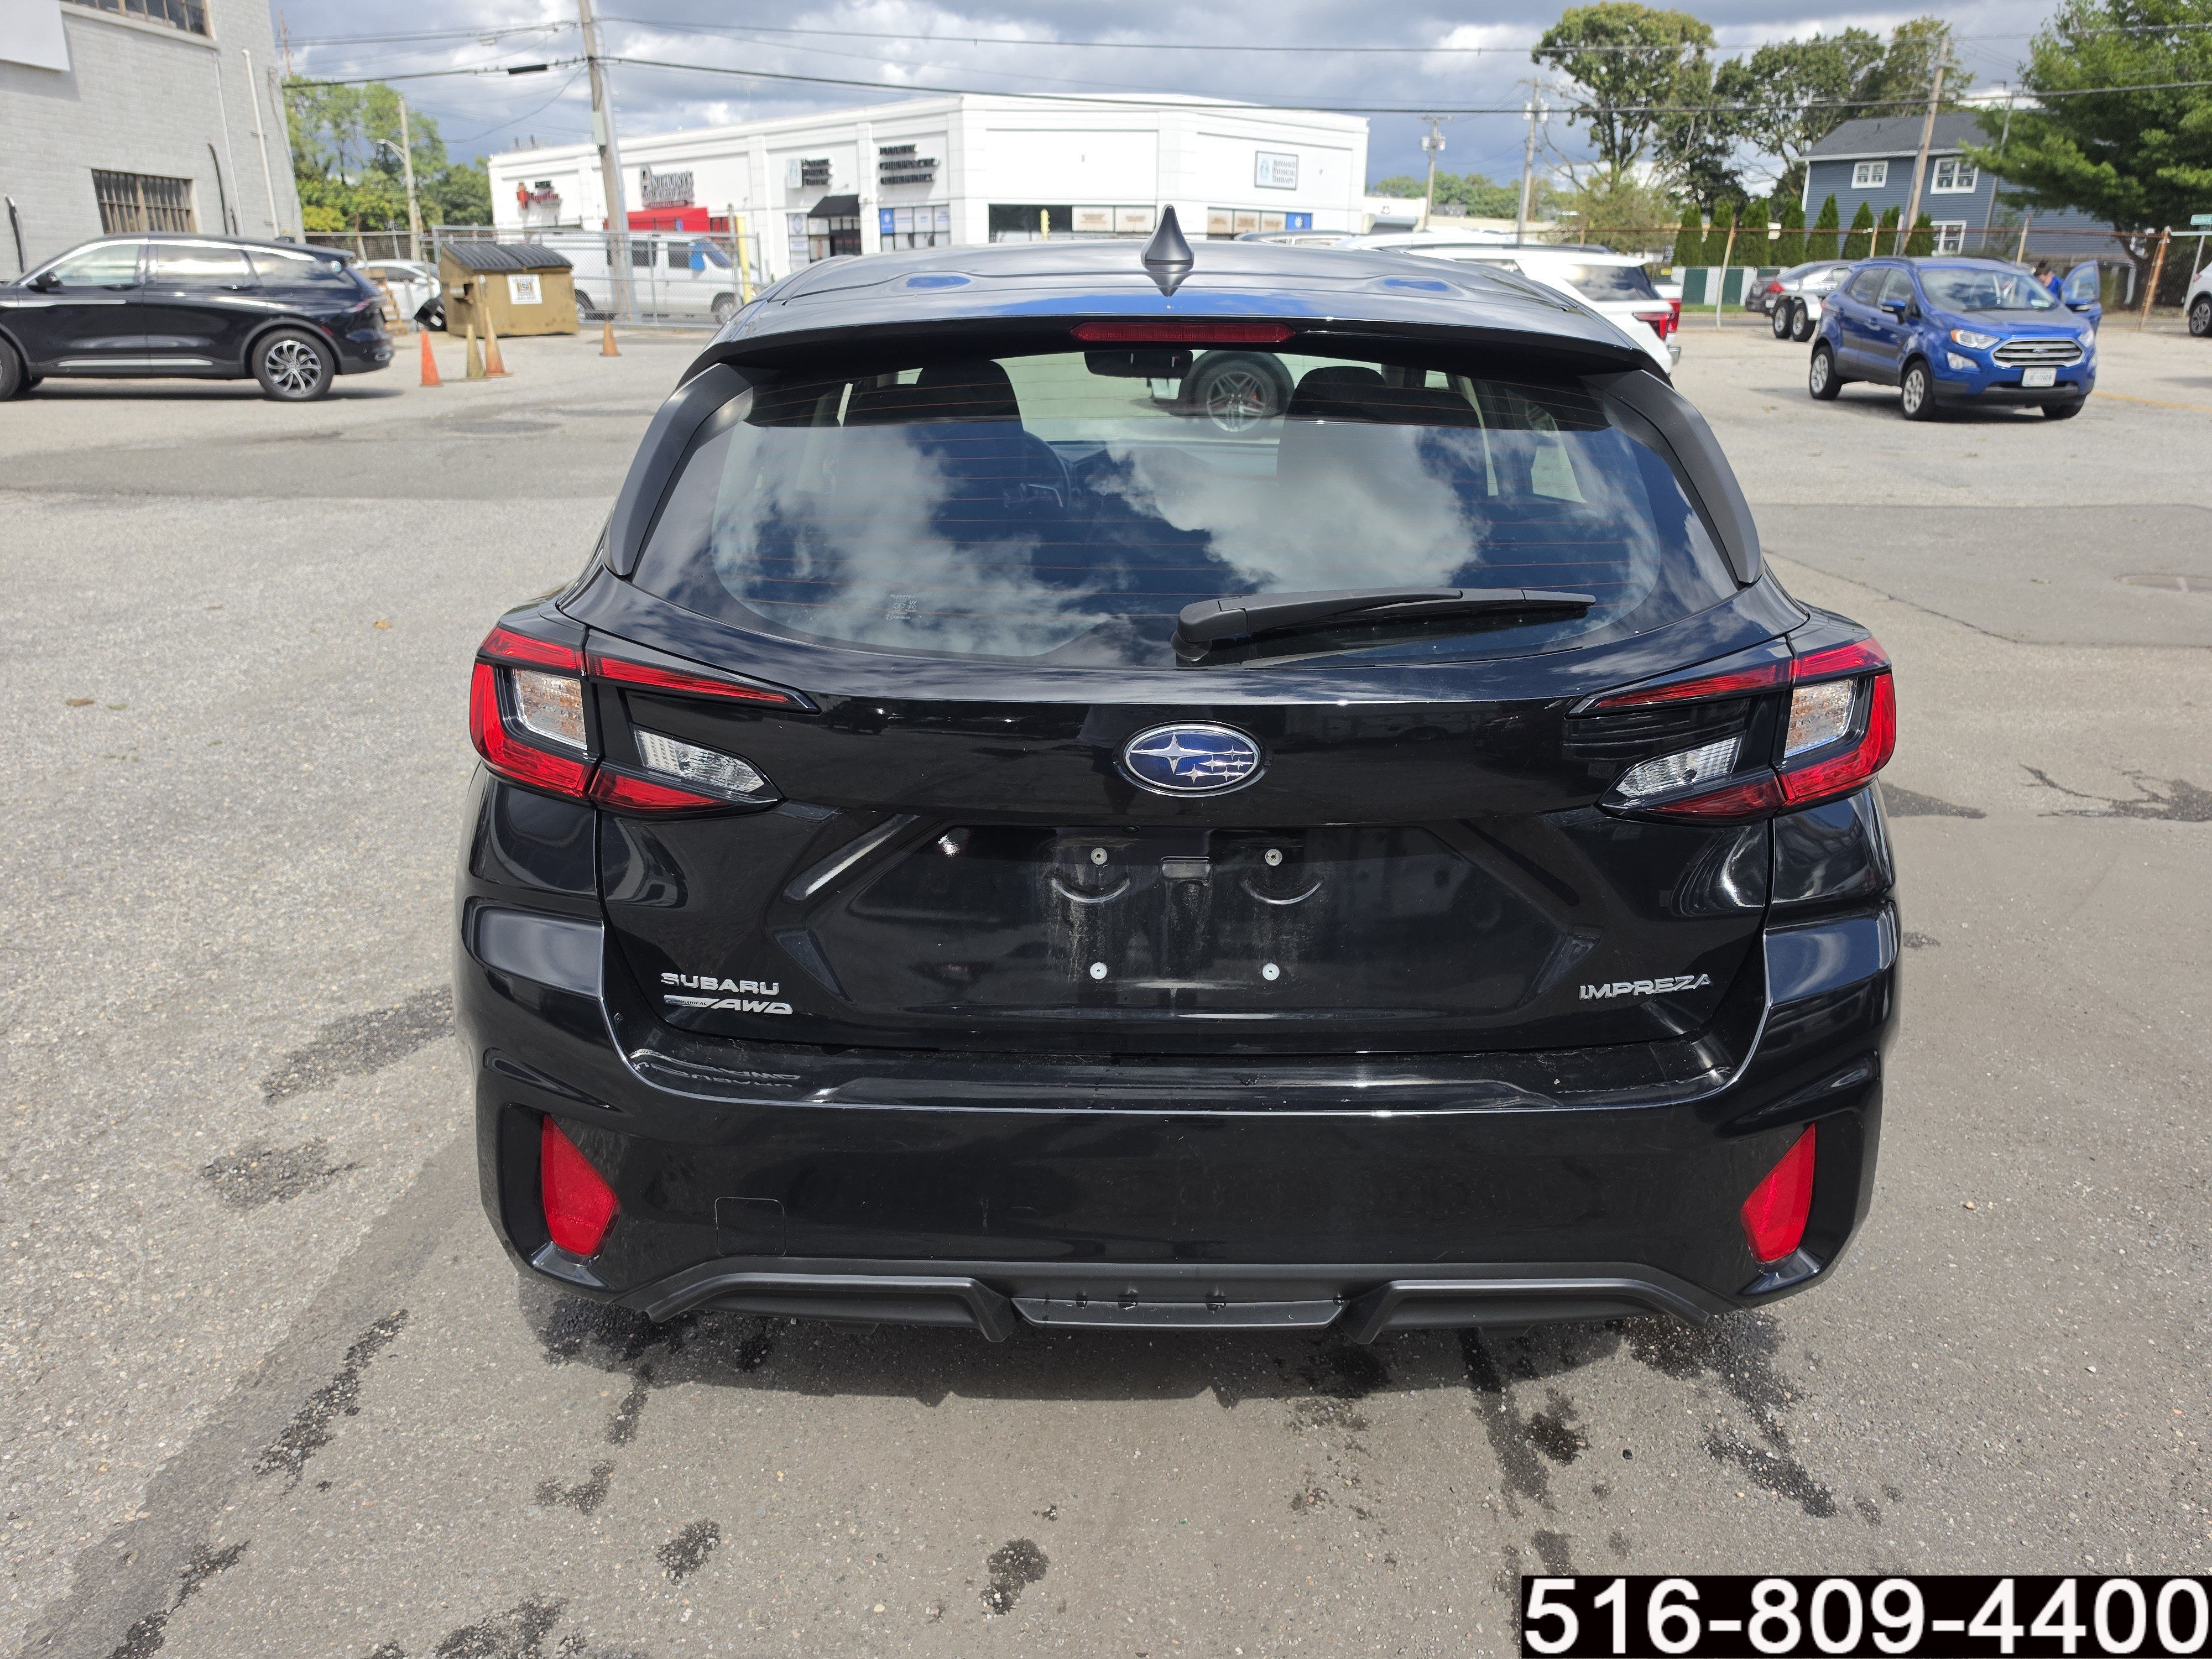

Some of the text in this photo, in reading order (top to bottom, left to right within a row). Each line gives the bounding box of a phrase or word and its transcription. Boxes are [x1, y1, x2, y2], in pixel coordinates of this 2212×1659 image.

[661, 973, 779, 995] SUBARU
[1579, 973, 1712, 1000] IMPREZA
[711, 999, 794, 1015] AWD
